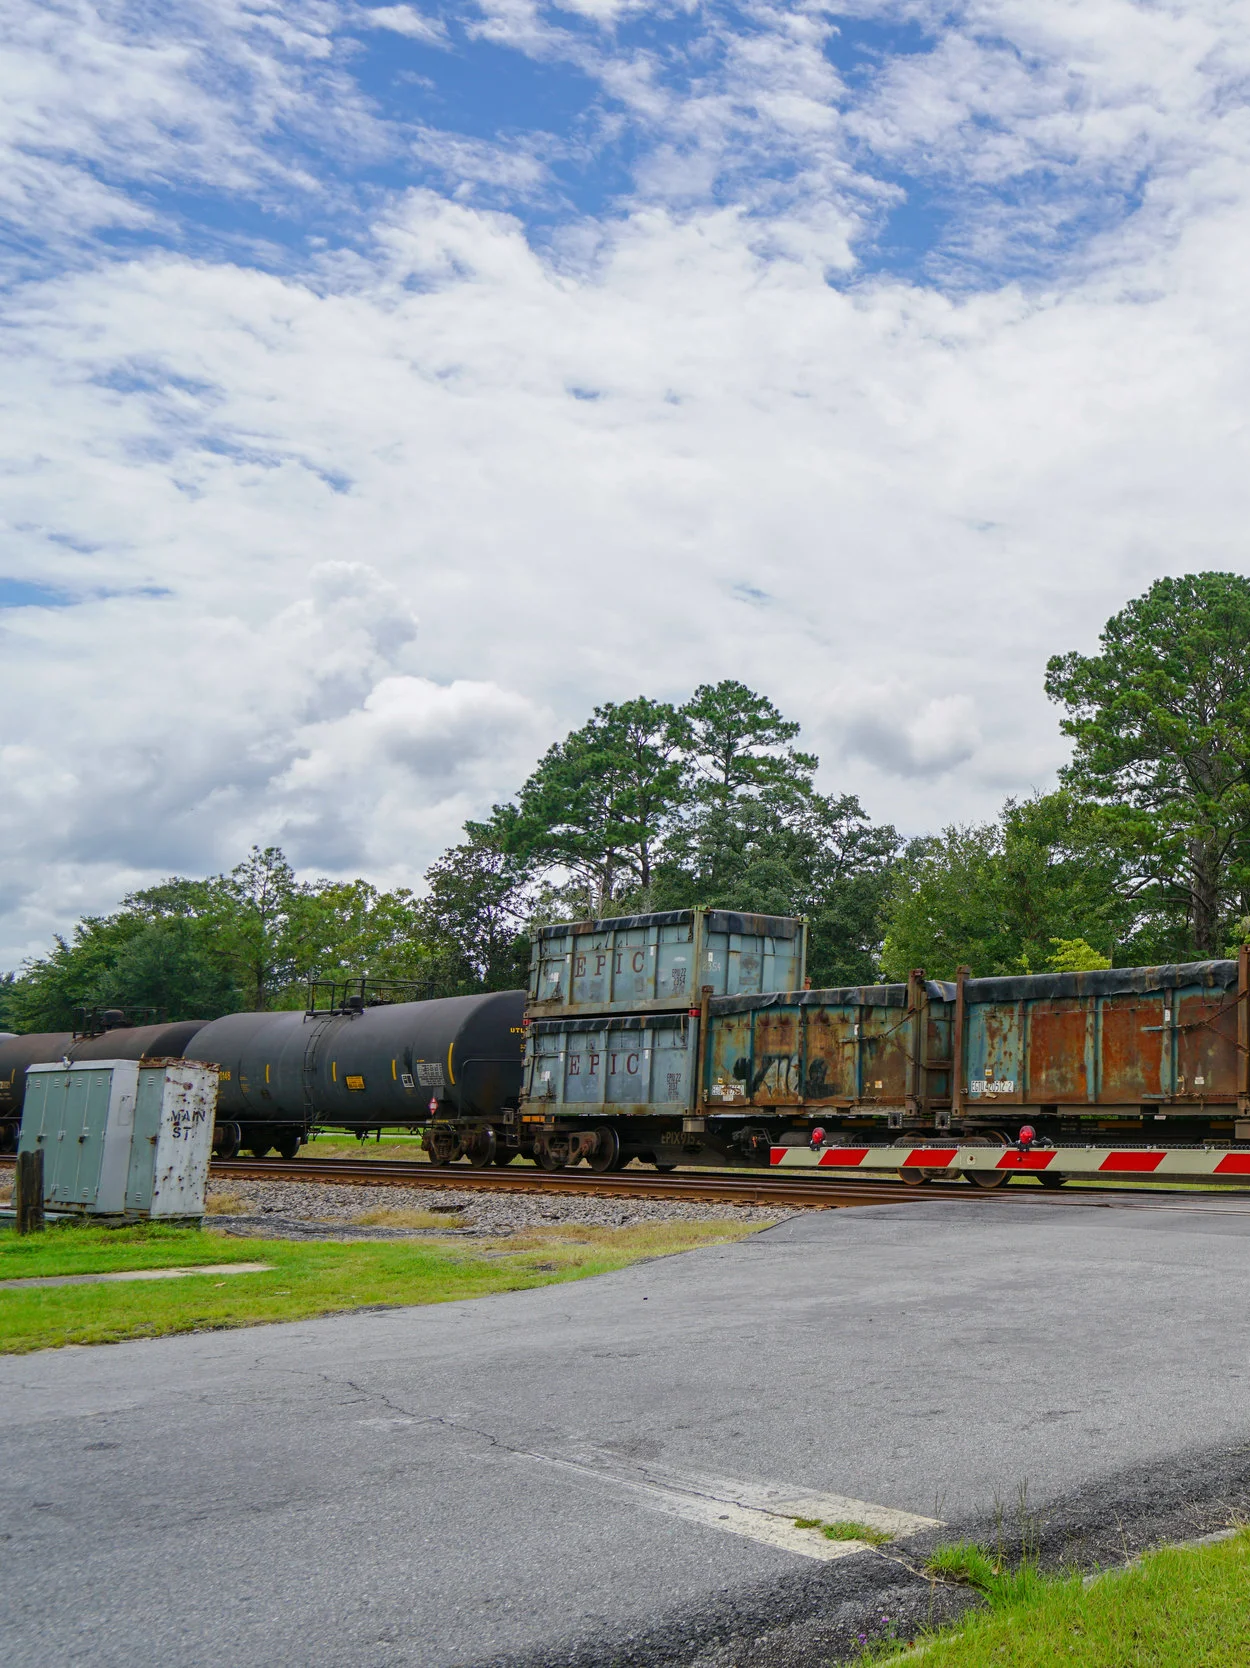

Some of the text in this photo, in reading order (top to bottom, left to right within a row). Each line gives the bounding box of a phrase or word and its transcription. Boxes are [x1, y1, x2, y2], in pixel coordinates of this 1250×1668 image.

[575, 952, 645, 978] EPIC
[568, 1053, 639, 1076] EPIC
[170, 1110, 206, 1122] MAIN
